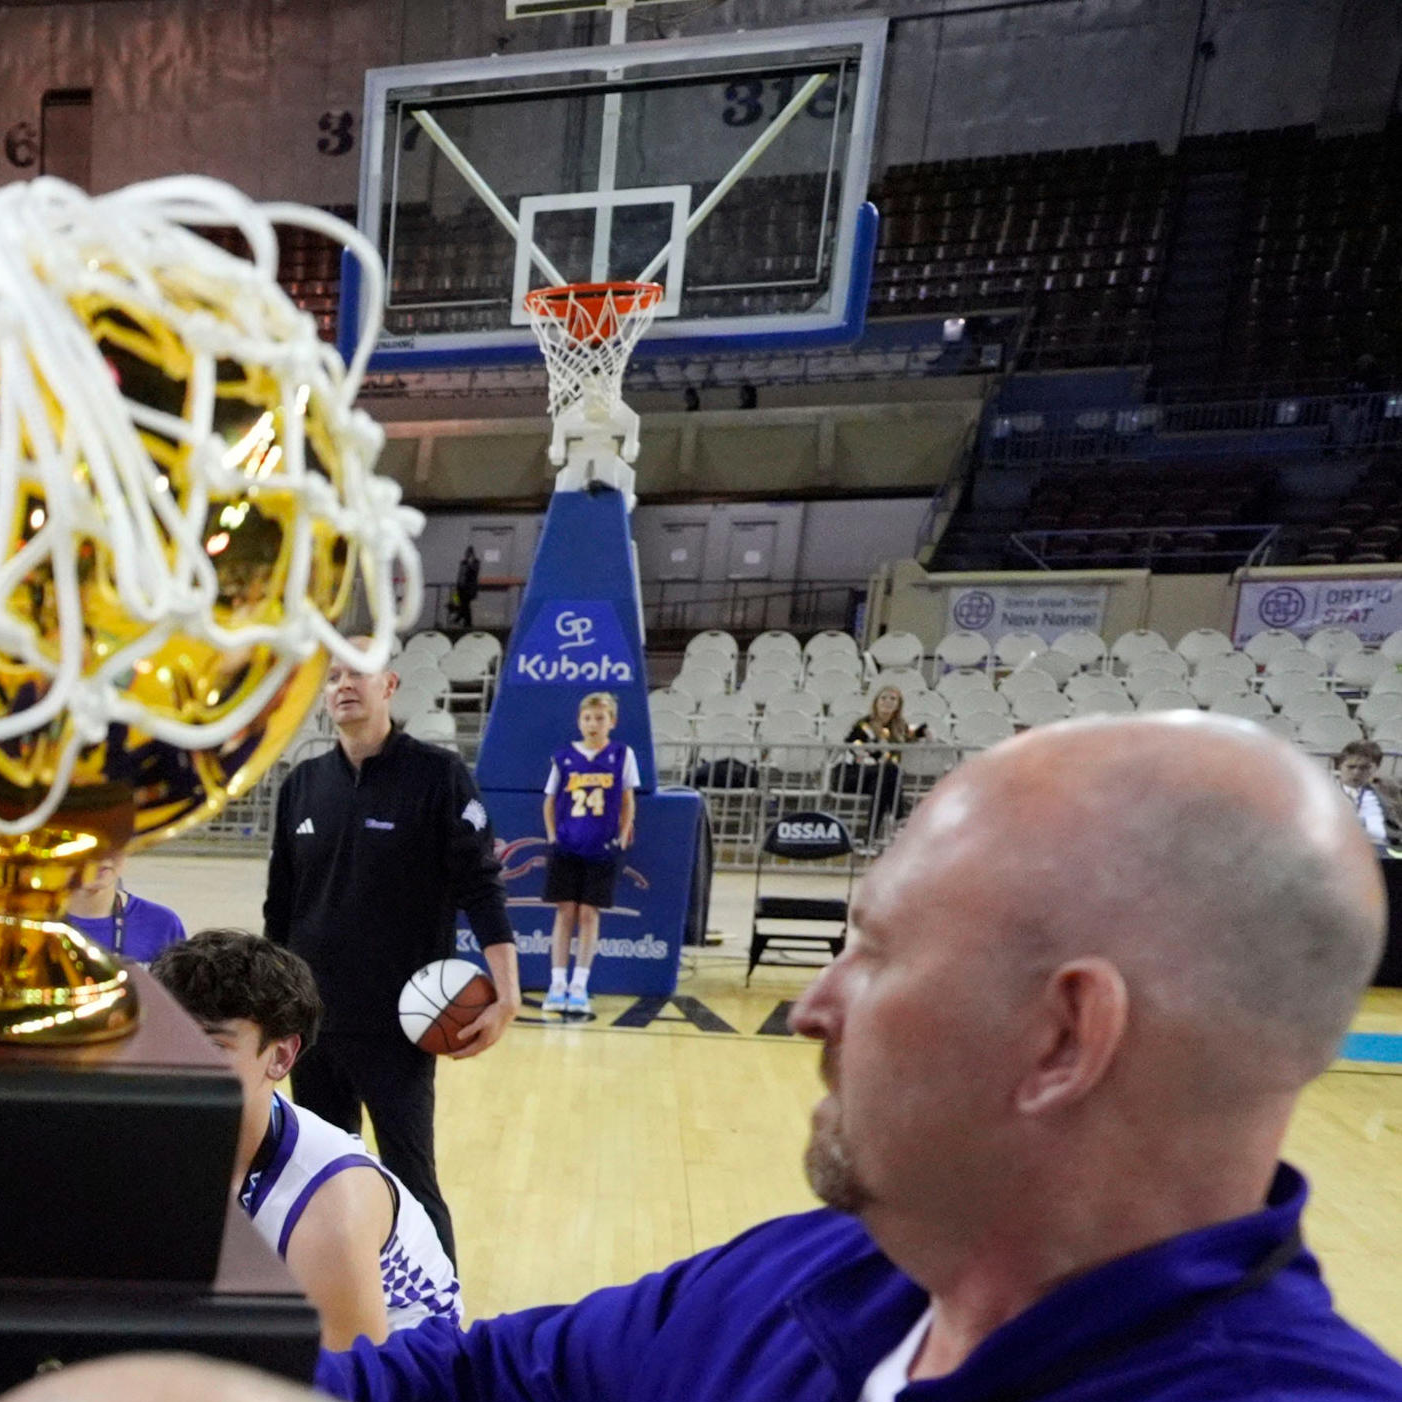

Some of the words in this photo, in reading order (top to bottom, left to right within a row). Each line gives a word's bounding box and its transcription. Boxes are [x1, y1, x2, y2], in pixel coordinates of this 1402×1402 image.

[317, 109, 425, 156] 37
[1326, 589, 1392, 604] ORTHO
[1002, 613, 1036, 626] New
[1322, 608, 1373, 624] STAT
[517, 654, 633, 681] Kubota
[571, 788, 605, 817] 24
[778, 822, 840, 839] OSSAA
